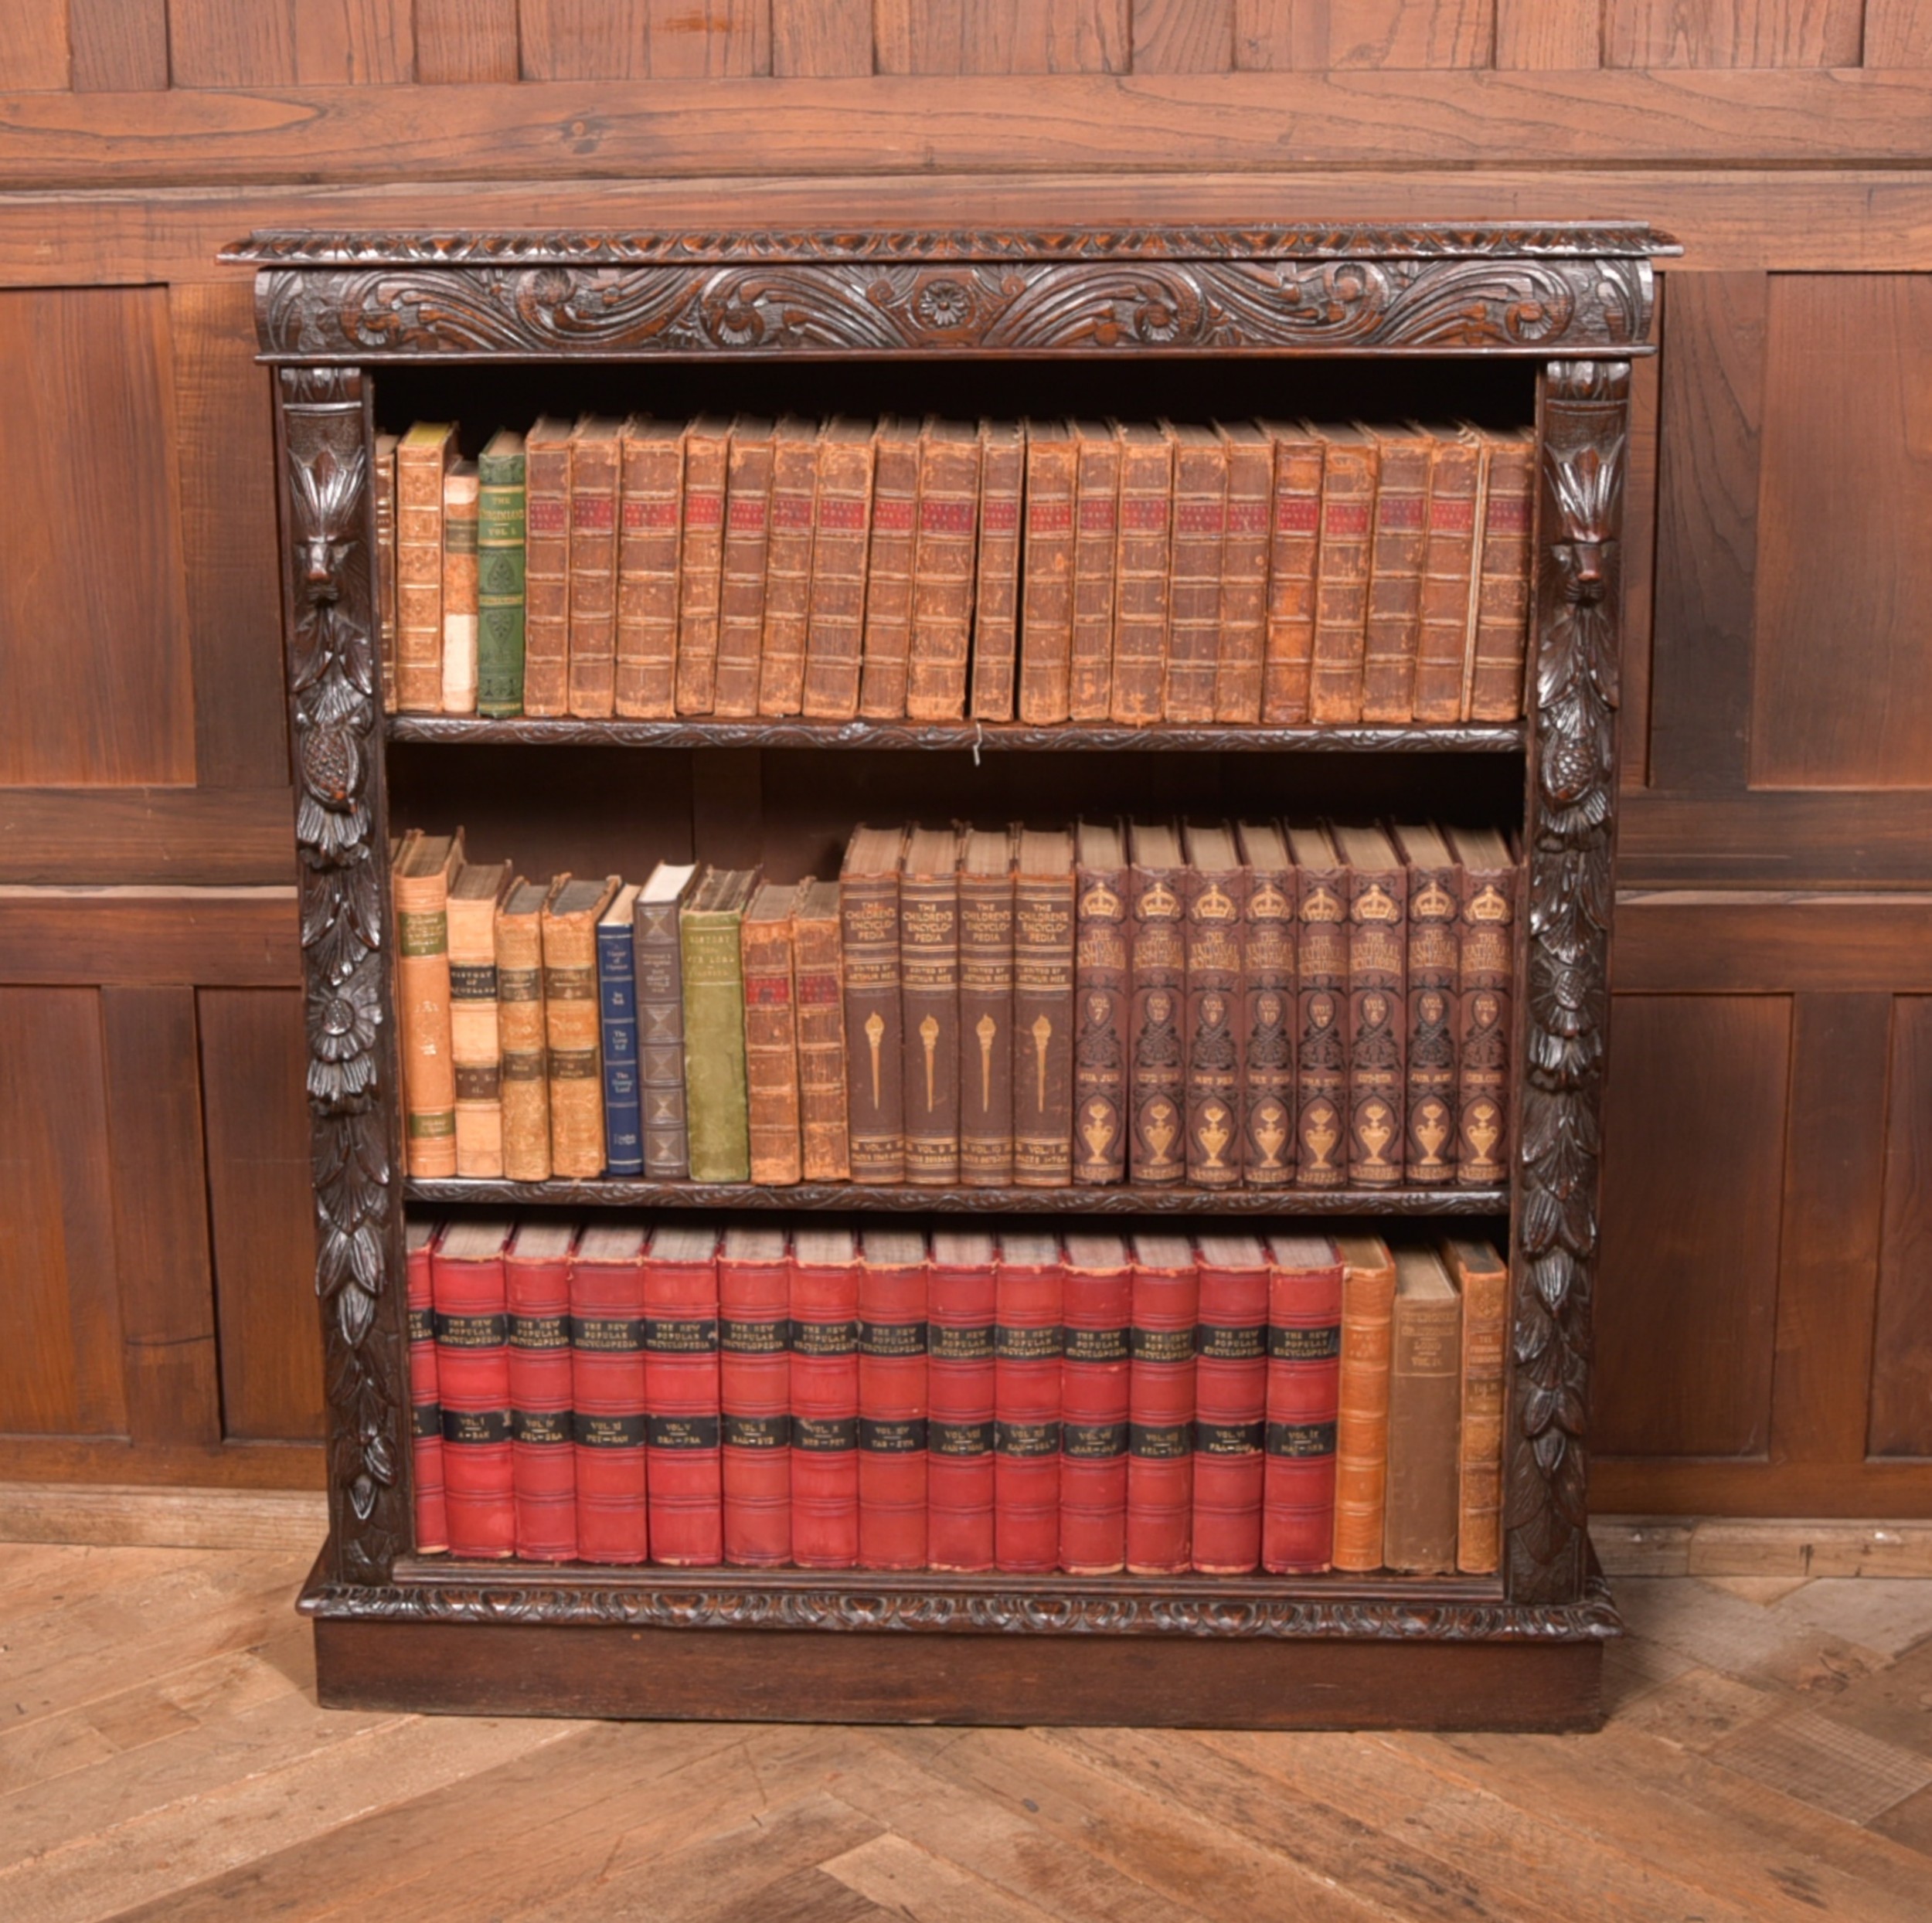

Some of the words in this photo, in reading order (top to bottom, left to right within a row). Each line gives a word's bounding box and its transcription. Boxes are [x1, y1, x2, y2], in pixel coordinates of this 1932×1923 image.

[917, 903, 936, 912] THE
[976, 902, 995, 912] THE
[1032, 903, 1052, 912] THE
[845, 907, 896, 919] CHILDREN'S
[902, 911, 954, 922] CHILDREN'S
[961, 910, 1012, 922] CHILDREN'S
[1017, 911, 1069, 922] CHILDREN'S
[850, 919, 895, 929] ENCYCLO-
[906, 922, 952, 933] ENCYCLO-
[966, 922, 1011, 932] ENCYCLO-
[1022, 922, 1068, 933] ENCYCLO-
[858, 930, 886, 940] PEDIA
[914, 933, 942, 943] PEDIA
[972, 933, 1001, 943] PEDIA
[1029, 933, 1056, 943] PEDIA
[963, 973, 992, 982] ARTHUR
[1019, 974, 1048, 983] ARTHUR
[539, 1320, 560, 1328] NEW
[730, 1323, 747, 1332] THE
[754, 1324, 775, 1333] NEW
[517, 1329, 560, 1337] POPULAR
[803, 1325, 820, 1334] THE
[942, 1330, 960, 1339] THE
[966, 1330, 986, 1339] NEW
[1215, 1330, 1233, 1339] THE
[1309, 1330, 1328, 1339] NEW
[730, 1332, 773, 1340] POPULAR
[1145, 1342, 1188, 1351] POPULAR
[1285, 1340, 1327, 1348] POPULAR
